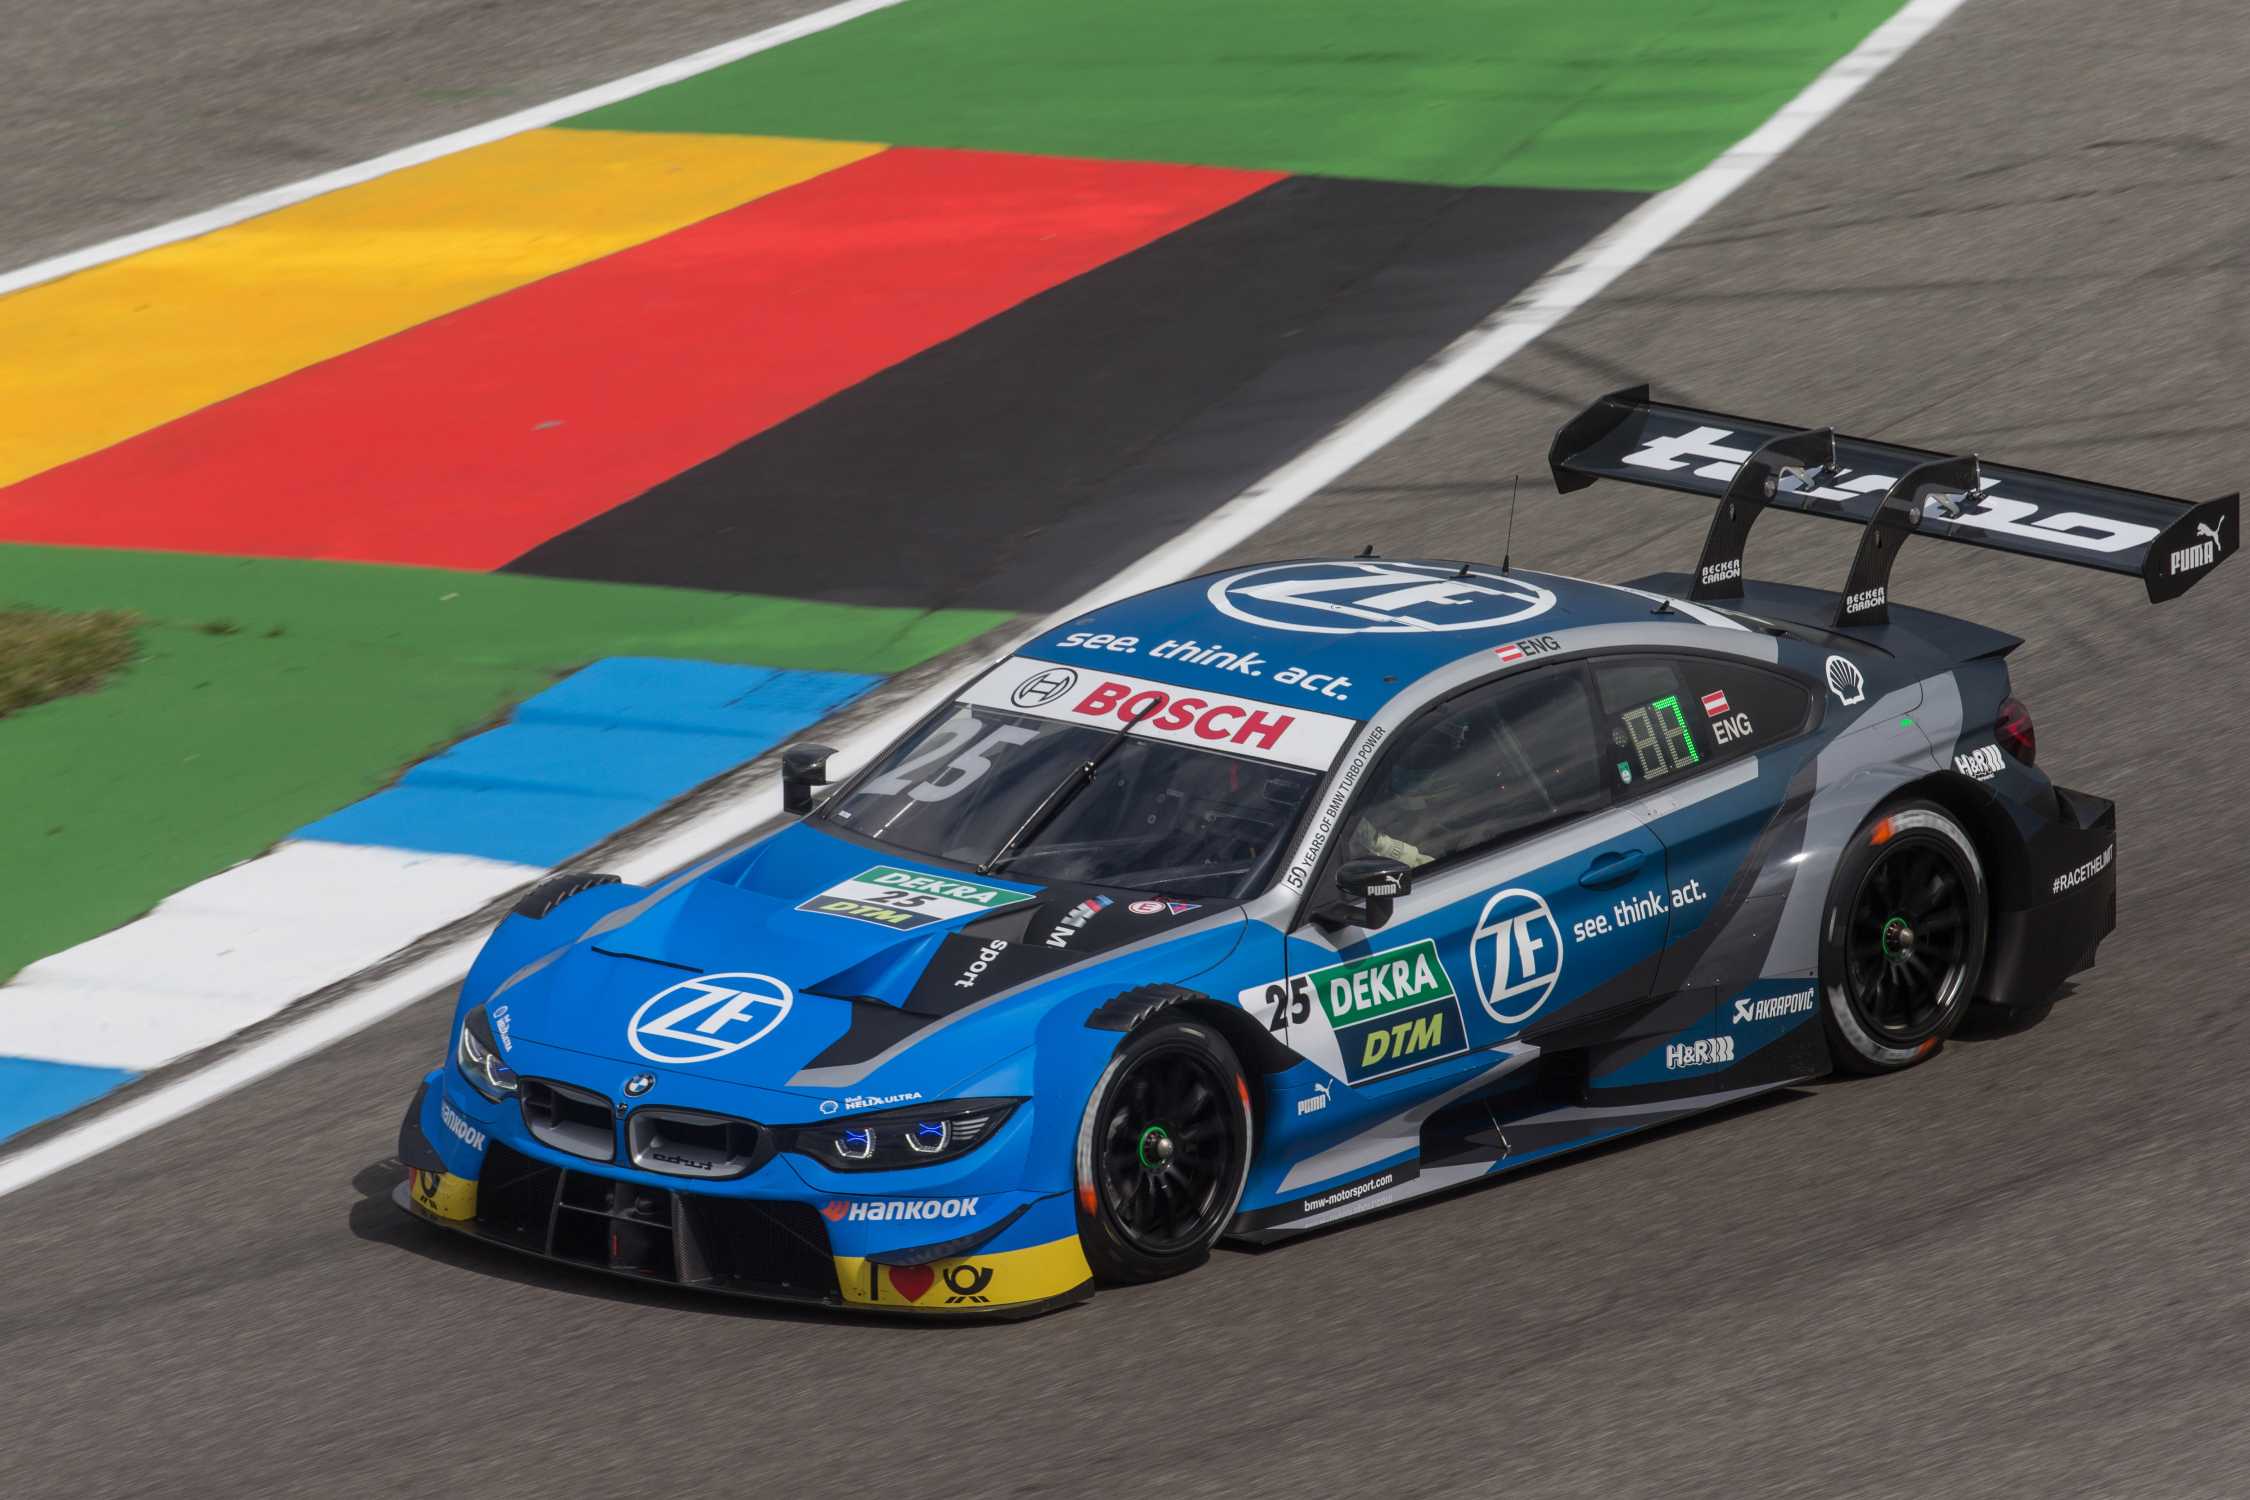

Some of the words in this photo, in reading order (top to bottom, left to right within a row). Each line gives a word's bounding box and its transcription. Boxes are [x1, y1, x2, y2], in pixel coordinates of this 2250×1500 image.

[1702, 559, 1740, 576] BECKER
[2171, 541, 2214, 576] PUMA
[1702, 568, 1741, 585] CARBON
[1224, 564, 1545, 632] ZF
[1846, 587, 1884, 605] BECKER
[1846, 596, 1885, 614] CARBON
[1518, 635, 1561, 657] ENG
[1056, 632, 1140, 653] see.
[1149, 638, 1266, 677] think.
[1273, 667, 1352, 701] act.
[1072, 681, 1296, 750] BOSCH
[1712, 712, 1753, 745] ENG
[1358, 726, 1386, 760] POWER
[857, 716, 1040, 802] 25
[1954, 747, 1995, 777] H&R
[1339, 758, 1364, 794] TURBO
[1326, 790, 1345, 819] BMW
[1320, 818, 1334, 834] OF
[1302, 832, 1326, 869] YEARS
[874, 873, 998, 903] DEKRA
[1287, 866, 1307, 889] 50
[1368, 884, 1397, 896] PUMA
[820, 901, 913, 924] DTM
[867, 890, 938, 908] 25
[1573, 919, 1612, 943] see.
[1614, 890, 1669, 927] think.
[1671, 879, 1707, 908] act.
[1473, 900, 1559, 1006] ZF
[1330, 953, 1438, 1017] DEKRA
[634, 976, 787, 1051] ZF
[1265, 977, 1311, 1032] 25
[1361, 1012, 1443, 1067] DTM
[1666, 1039, 1714, 1069] H&R
[884, 1092, 922, 1104] ULTRA
[1297, 1094, 1326, 1116] PUMA
[1304, 1174, 1393, 1212] bmw-motorsport.com
